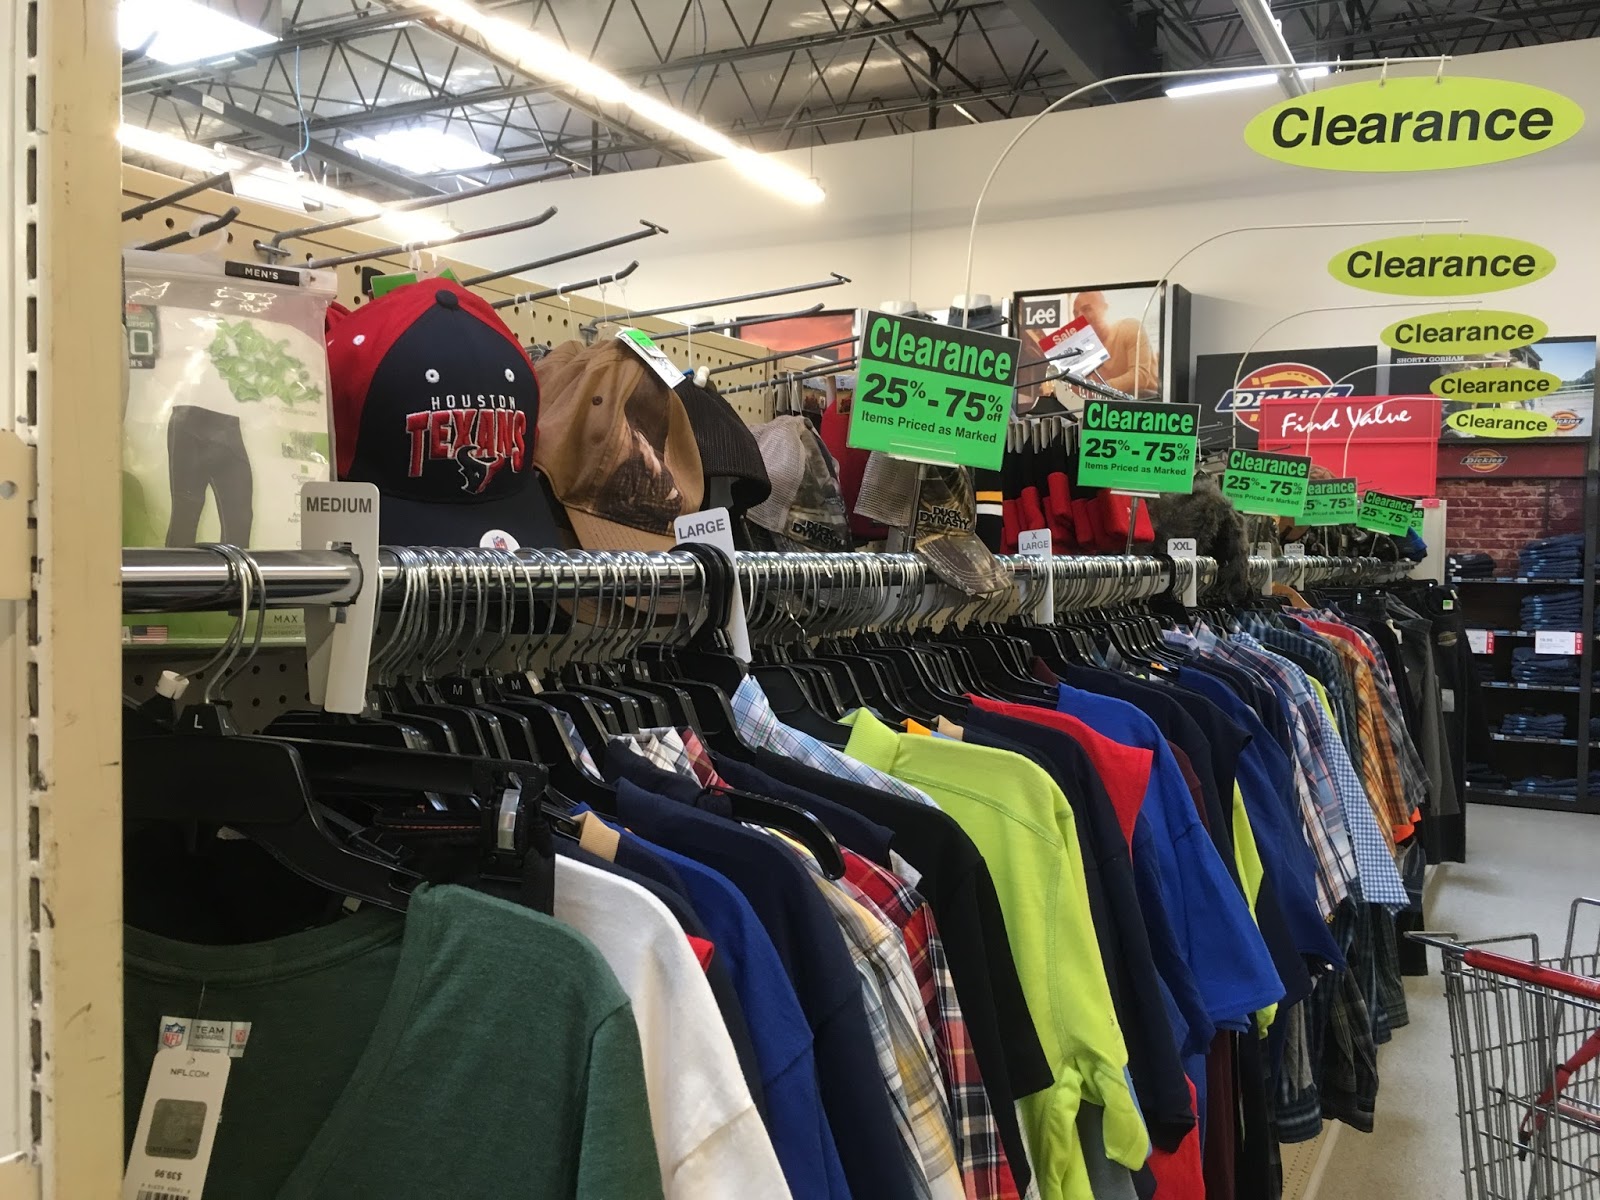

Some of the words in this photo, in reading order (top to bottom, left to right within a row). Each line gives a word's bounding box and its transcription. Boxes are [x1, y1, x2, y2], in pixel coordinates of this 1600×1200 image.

[1272, 106, 1554, 148] Clearance
[1347, 250, 1536, 278] Clearance
[244, 267, 279, 280] MEN'S
[1025, 306, 1057, 326] Lee
[1052, 327, 1077, 344] Sale
[1395, 323, 1535, 344] Clearance
[869, 317, 1012, 381] Clearance
[1440, 378, 1550, 394] Clearance
[430, 394, 516, 410] HOUSTON
[986, 412, 1002, 423] off
[1086, 402, 1194, 433] Clearance
[1281, 408, 1341, 438] Find
[1346, 404, 1412, 429] Value
[1456, 413, 1548, 432] Clearance
[861, 410, 894, 426] Items
[897, 416, 936, 433] Priced
[938, 424, 952, 435] as
[955, 426, 997, 444] Marked
[405, 408, 527, 477] TEXANS
[1085, 461, 1109, 470] Items
[1110, 462, 1139, 472] Priced
[1153, 466, 1187, 476] Marked
[1230, 450, 1307, 476] Clearance
[1308, 482, 1355, 494] earance
[306, 496, 372, 513] MEDIUM
[1244, 493, 1265, 501] Priced
[1275, 497, 1299, 505] Marked
[1365, 491, 1413, 511] Clearance
[918, 509, 971, 530] DYNASTY
[931, 505, 962, 520] DUCK
[678, 518, 726, 540] LARGE
[1021, 540, 1049, 551] LARGE
[1172, 541, 1193, 551] XXL
[273, 614, 298, 623] MAX
[452, 684, 463, 696] M
[511, 679, 521, 690] M
[194, 714, 203, 729] L
[195, 1025, 225, 1034] TEAM
[170, 1068, 210, 1078] NFL.COM
[154, 1168, 183, 1181] $39.99
